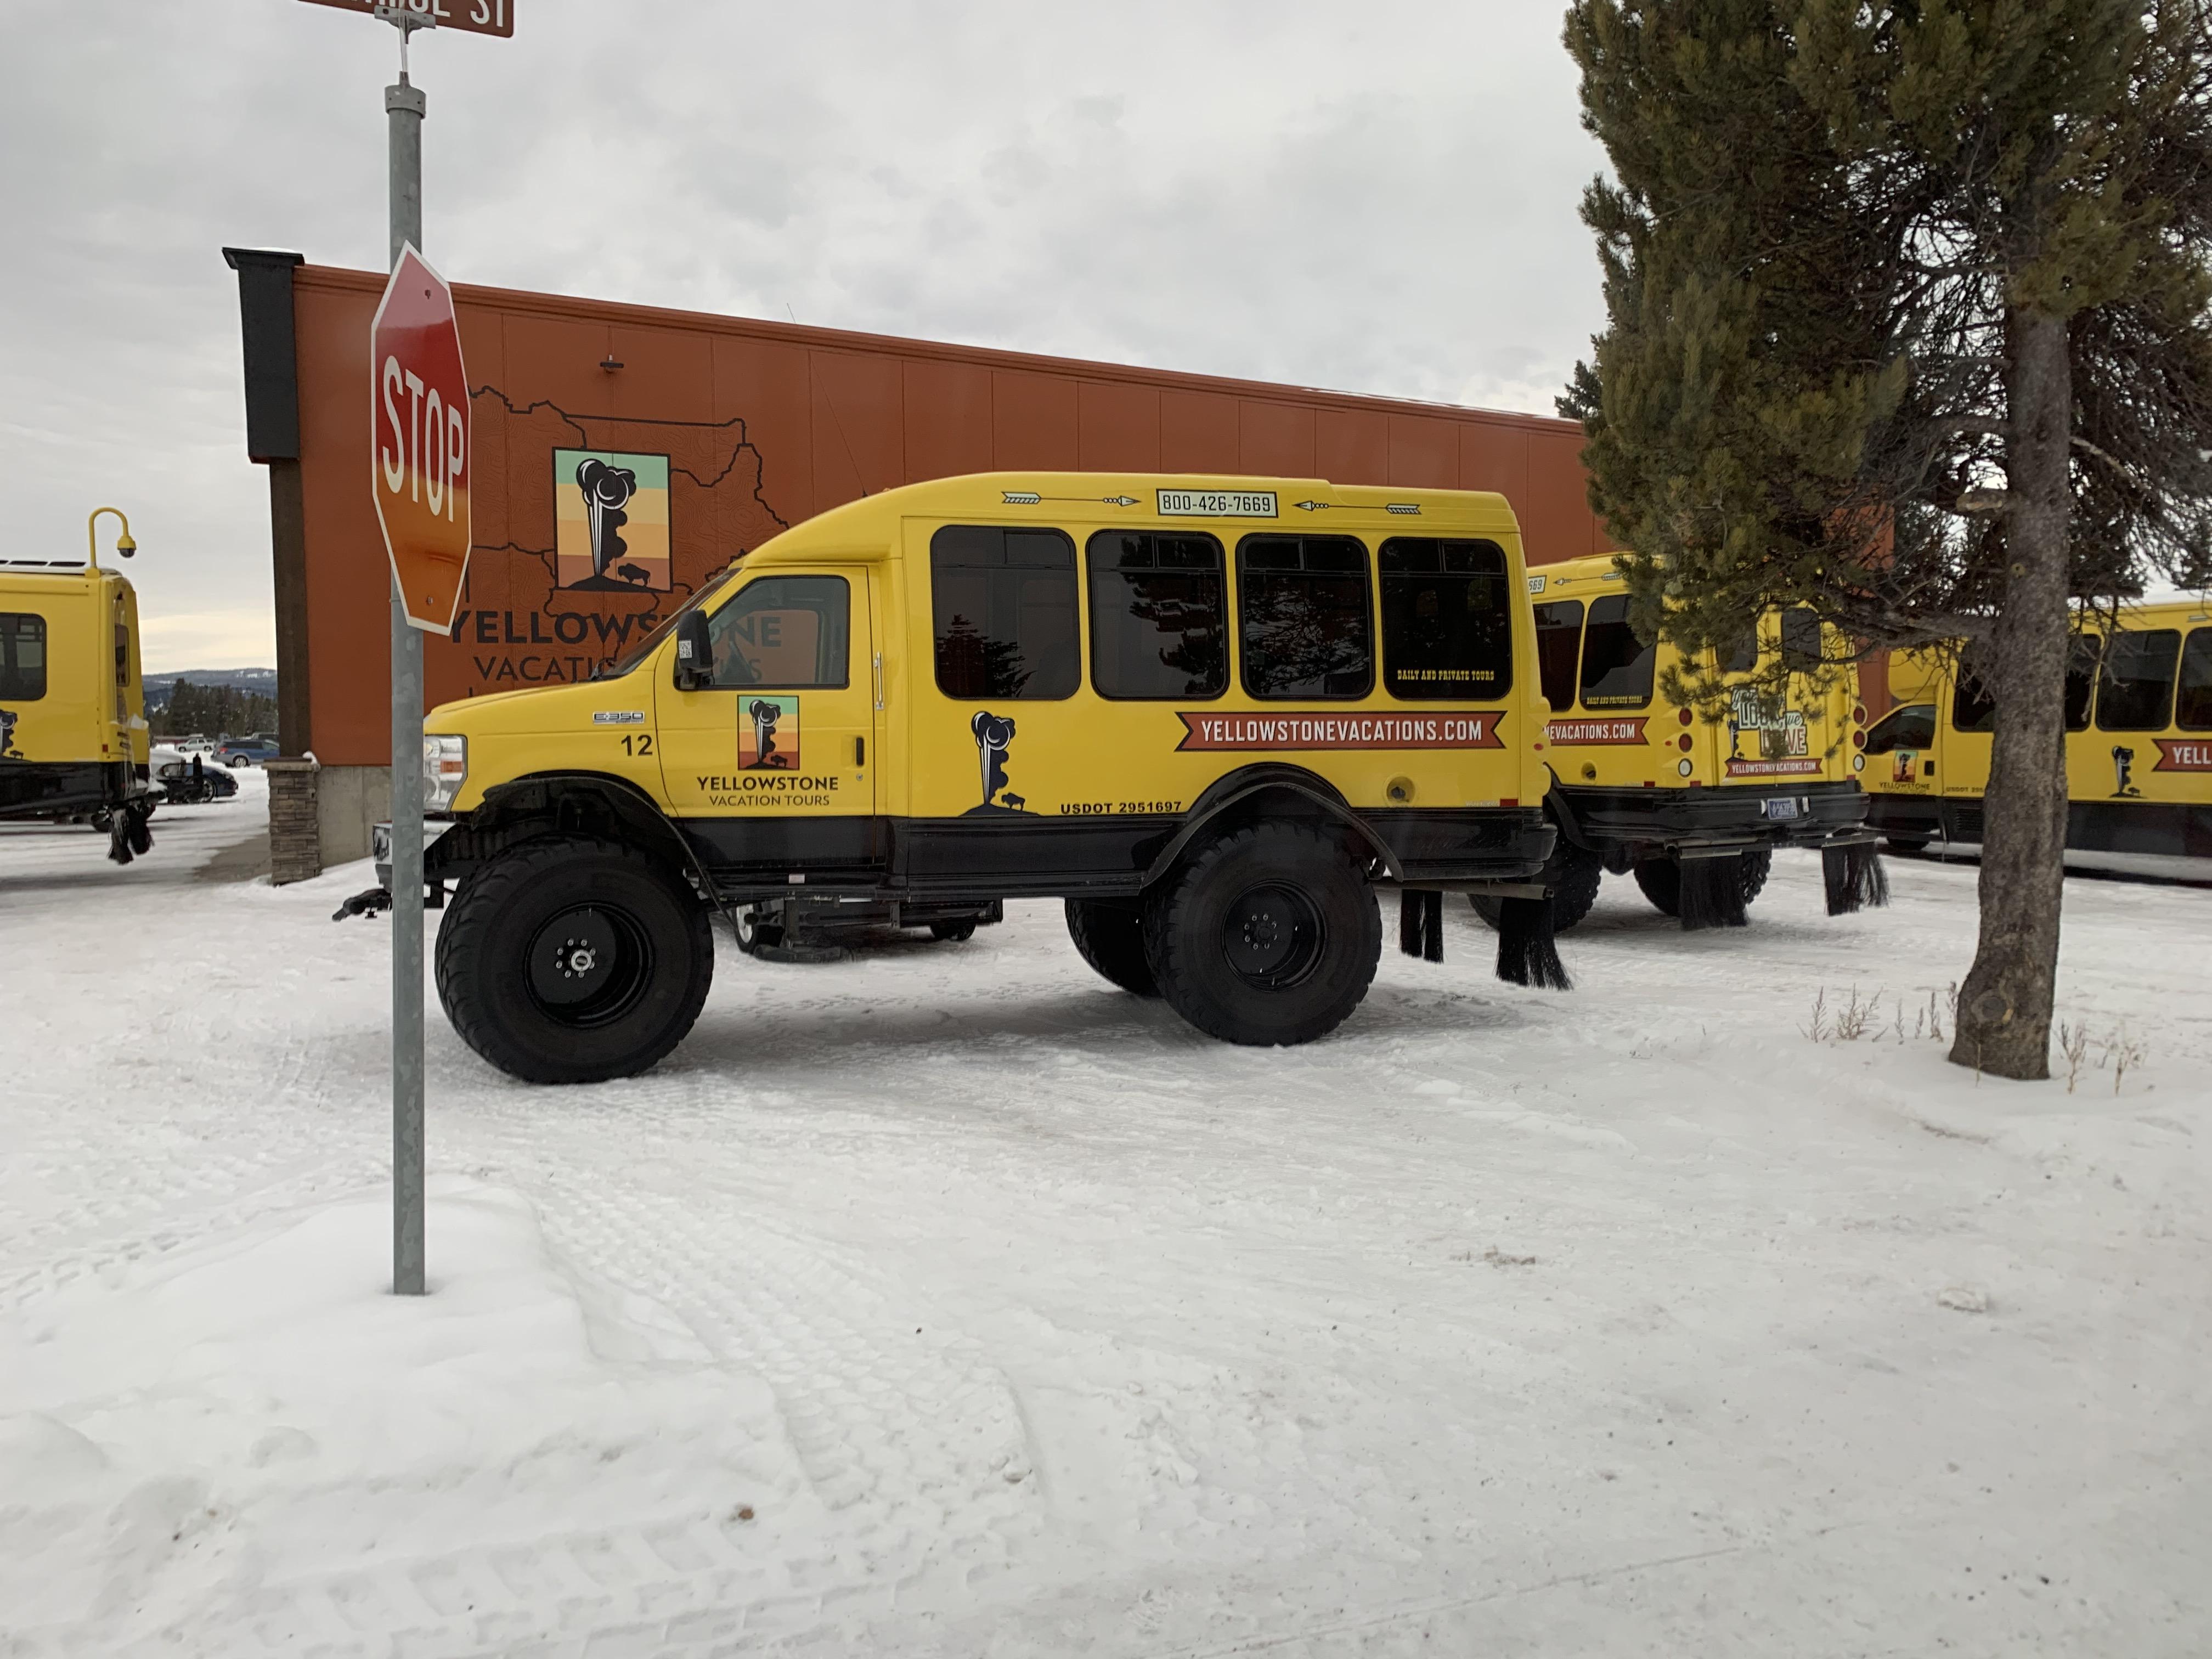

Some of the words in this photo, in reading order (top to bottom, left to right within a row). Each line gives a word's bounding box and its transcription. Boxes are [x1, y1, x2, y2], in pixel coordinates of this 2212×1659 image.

[382, 356, 464, 522] STOP
[1163, 495, 1271, 512] 800-426-7669
[1397, 669, 1419, 680] DAILY
[1421, 669, 1437, 680] AND
[1438, 670, 1470, 681] PRIVATE
[1471, 670, 1494, 681] TOURS
[1201, 720, 1482, 742] YELLOWSTONEVACATIONS.COM
[621, 734, 653, 757] 12
[697, 776, 839, 791] YELLOWSTONE
[1878, 782, 1931, 791] YELLOWSTONE
[709, 794, 781, 806] VACATION
[785, 794, 830, 806] TOURS
[1060, 802, 1114, 815] USDOT
[1119, 801, 1182, 814] 2951697
